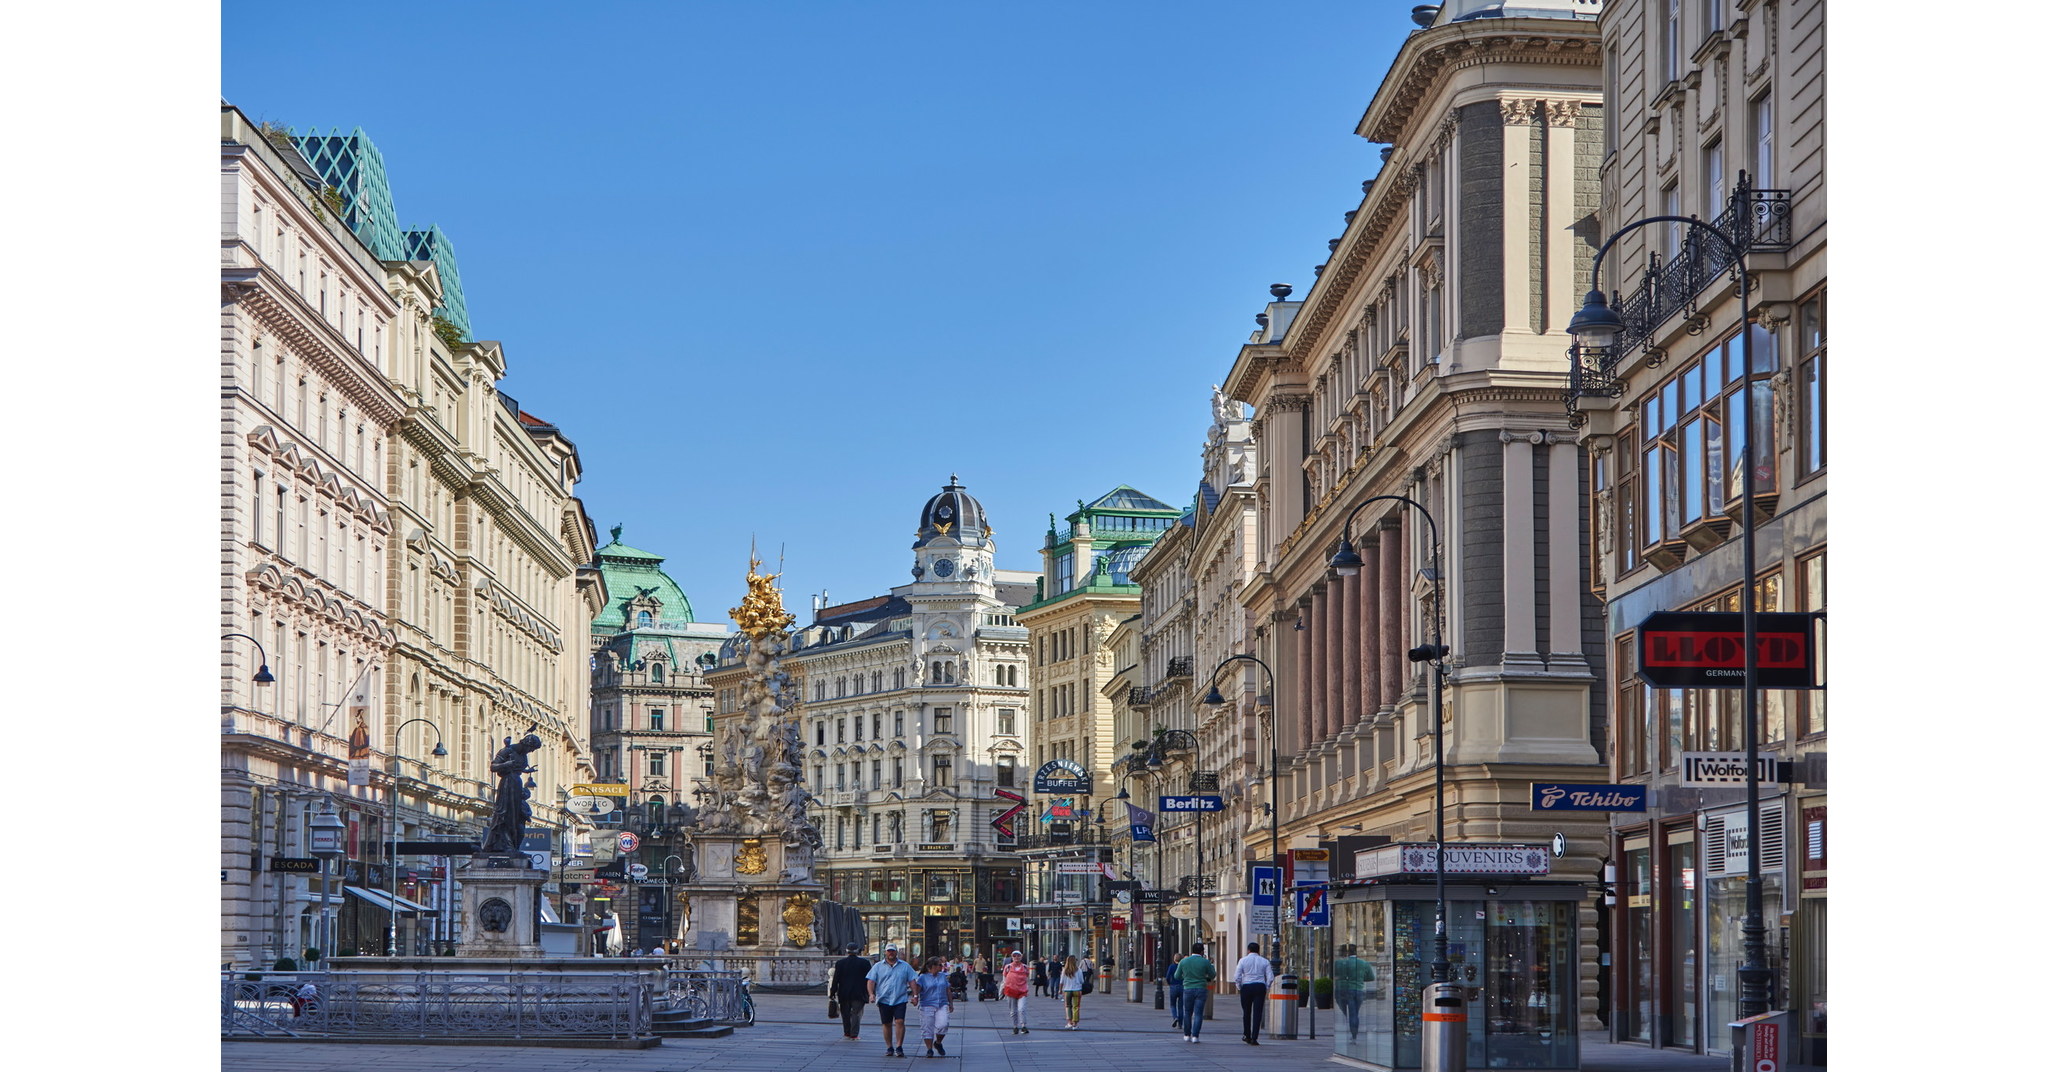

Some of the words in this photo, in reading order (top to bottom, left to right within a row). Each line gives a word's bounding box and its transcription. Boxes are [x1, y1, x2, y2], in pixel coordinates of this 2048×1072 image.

[1654, 636, 1799, 662] LLOYD
[1706, 669, 1747, 677] GERMANY
[573, 800, 608, 808] WOREG
[1166, 798, 1214, 809] Berlitz
[1569, 790, 1640, 807] Tchibo
[1427, 851, 1523, 863] SOUVENIRS
[274, 861, 314, 869] ESCADA
